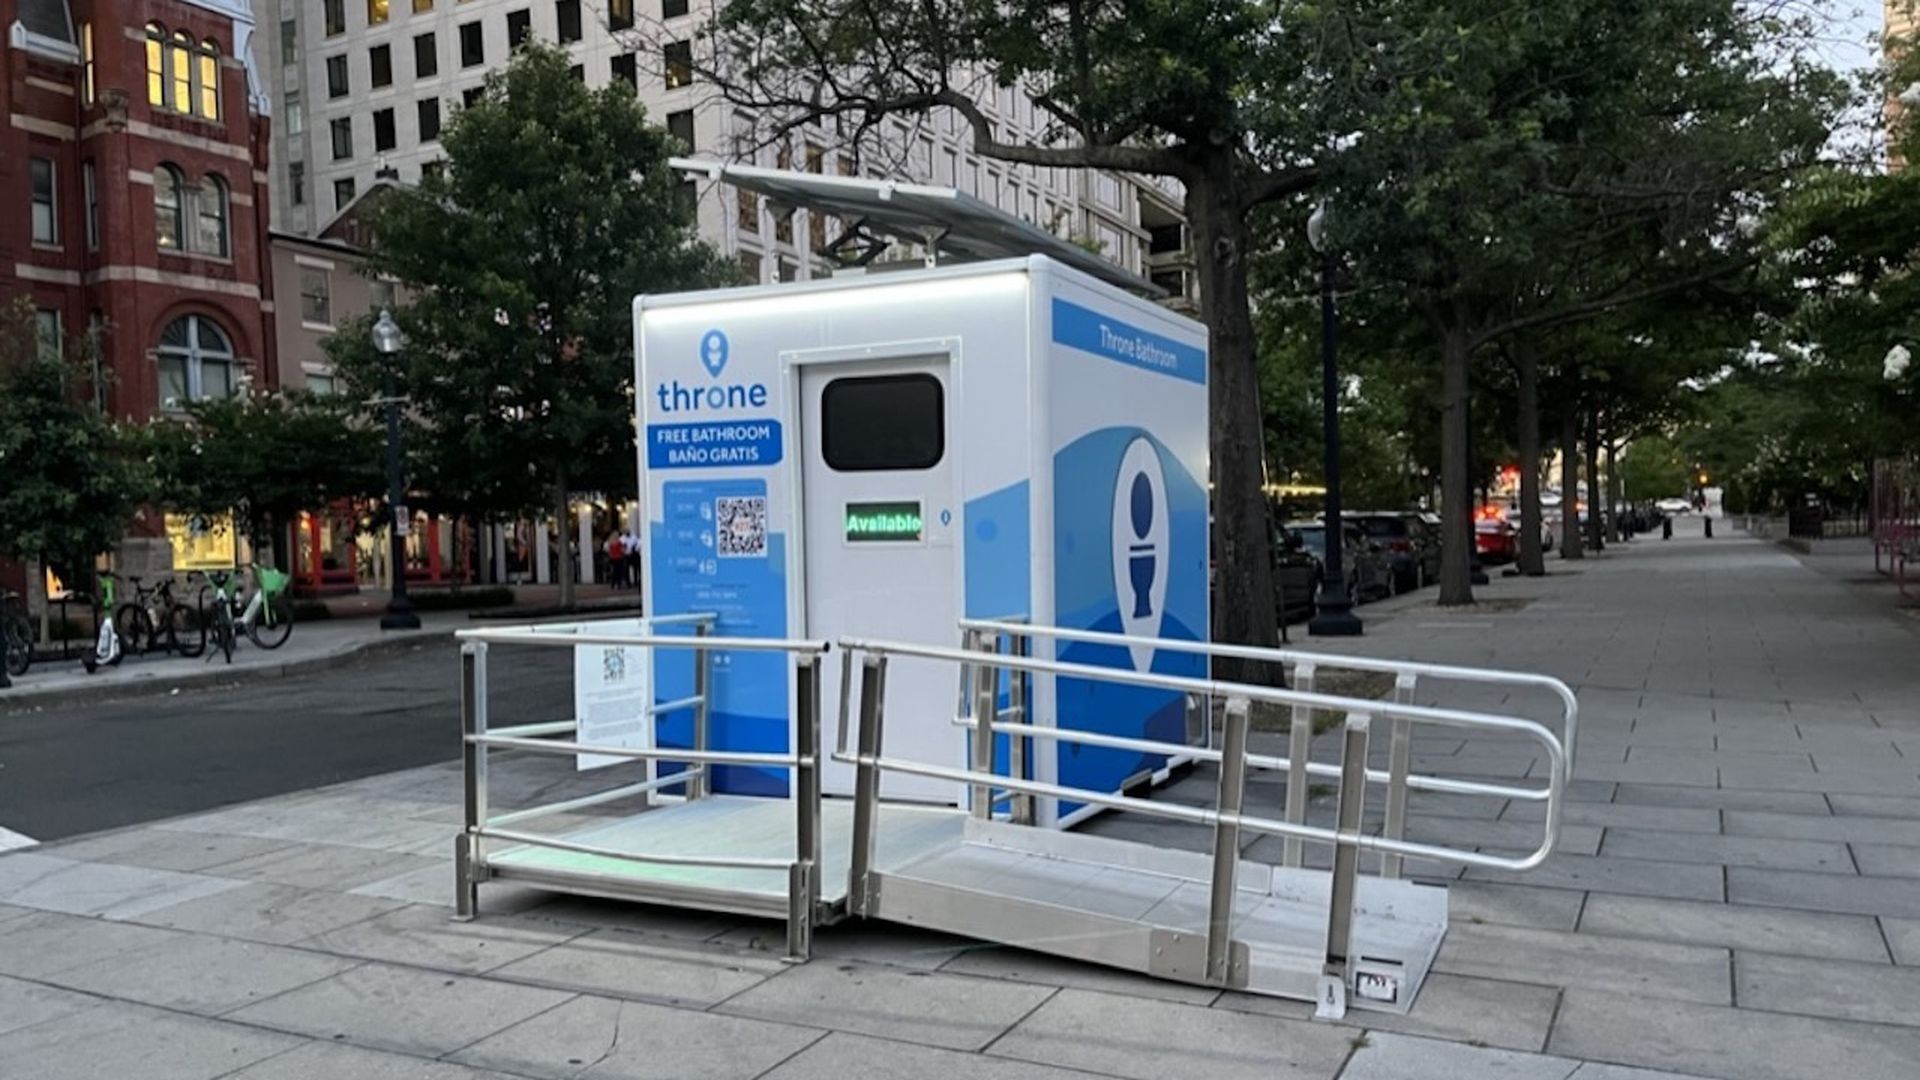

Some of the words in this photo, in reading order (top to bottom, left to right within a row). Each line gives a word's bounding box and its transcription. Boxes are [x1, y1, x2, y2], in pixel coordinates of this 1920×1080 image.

[1100, 324, 1135, 357] Throne
[1136, 337, 1177, 369] Bathroom
[657, 381, 767, 412] throne
[657, 428, 689, 444] FREE
[692, 427, 770, 442] BATHROOM
[668, 446, 708, 463] BAÑO
[709, 446, 759, 462] GRATIS
[847, 514, 922, 533] Available
